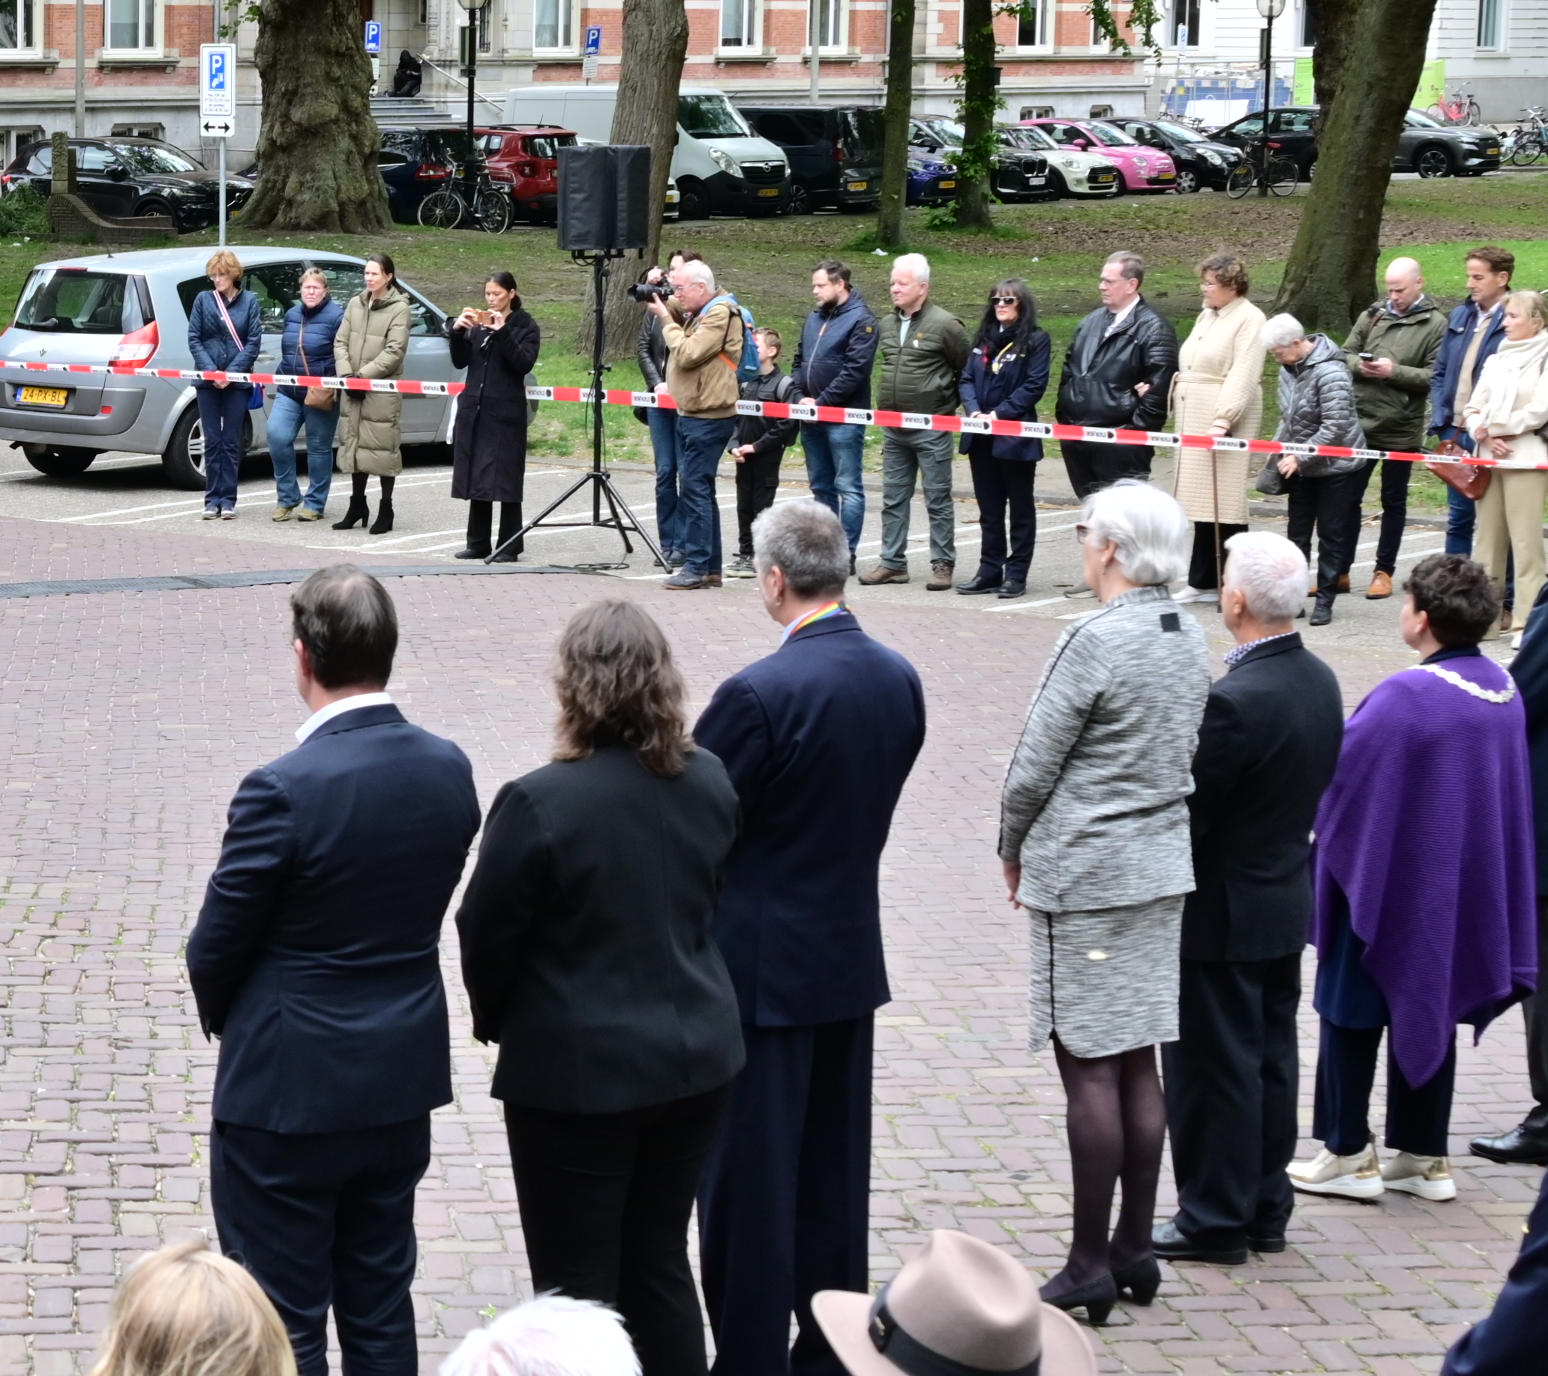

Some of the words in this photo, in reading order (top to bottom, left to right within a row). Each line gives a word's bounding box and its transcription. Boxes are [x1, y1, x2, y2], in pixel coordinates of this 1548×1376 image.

[369, 25, 378, 40] P
[588, 30, 599, 45] P
[211, 55, 222, 75] P
